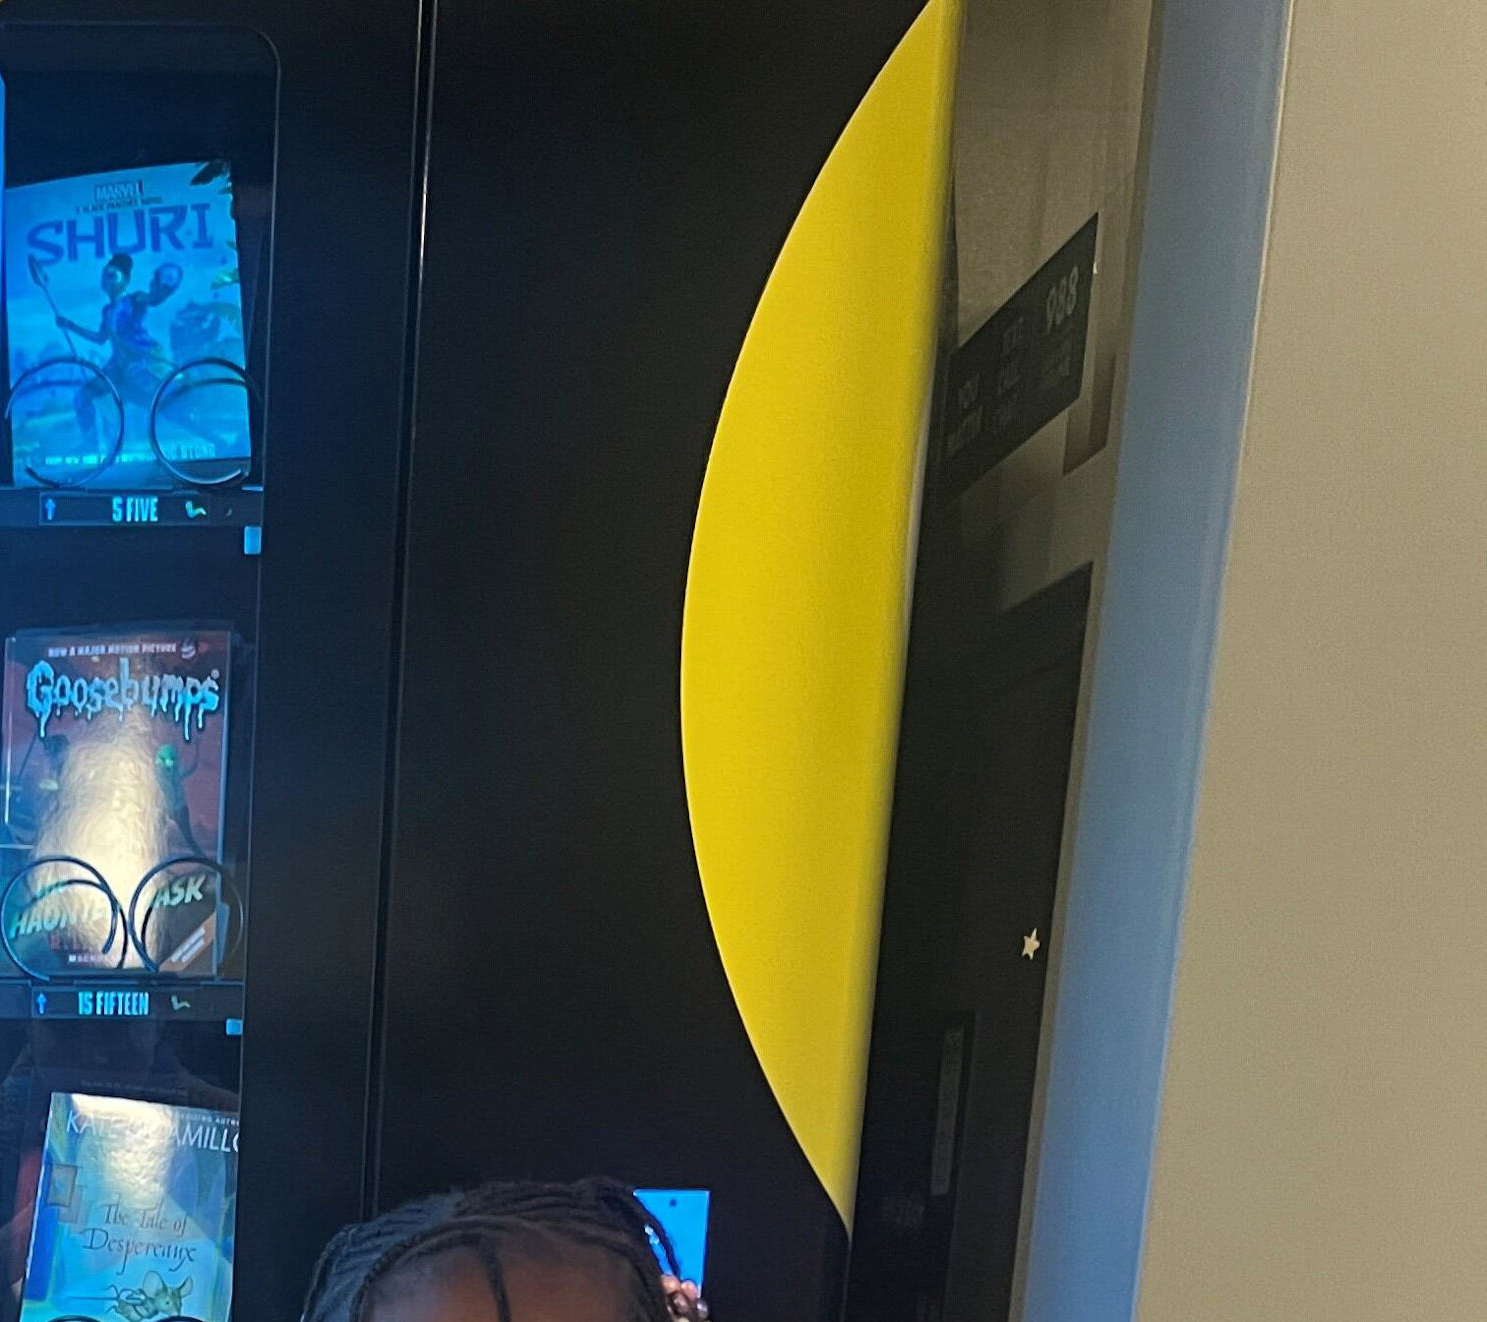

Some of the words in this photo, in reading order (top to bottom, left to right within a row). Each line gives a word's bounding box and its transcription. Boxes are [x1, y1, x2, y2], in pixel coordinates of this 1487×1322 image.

[26, 201, 213, 267] SHURI
[112, 497, 123, 522] 5
[125, 497, 159, 522] FIVE
[25, 657, 220, 736] Goosebumps
[77, 991, 94, 1016] 15
[95, 991, 150, 1016] FIFTEEN
[173, 1212, 192, 1238] of
[78, 1226, 198, 1277] Despereaux
